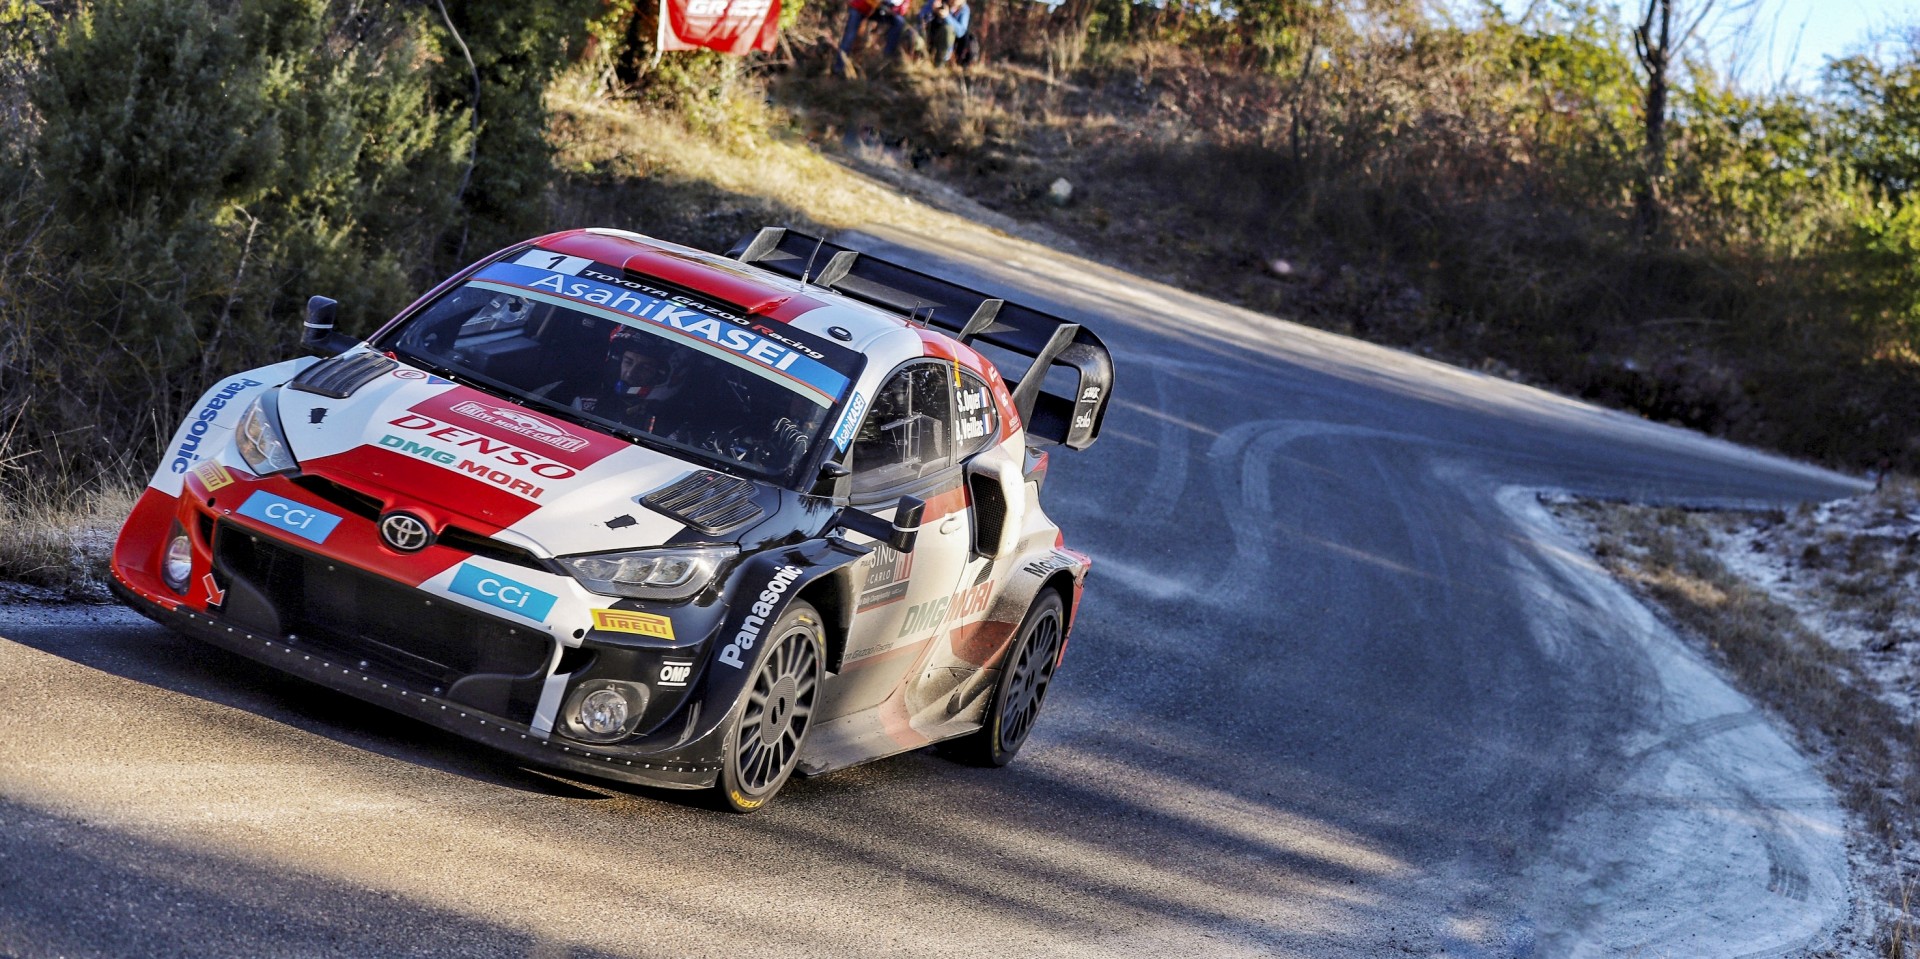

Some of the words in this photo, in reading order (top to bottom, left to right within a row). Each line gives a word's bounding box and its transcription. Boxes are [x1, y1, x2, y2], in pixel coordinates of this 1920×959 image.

[547, 255, 568, 270] 1
[528, 273, 800, 372] AsahiKASEI
[585, 269, 667, 298] TOYOTA
[671, 295, 750, 326] GAZOO
[752, 324, 825, 360] Racing
[171, 378, 264, 474] Panasonic
[455, 402, 497, 422] RALLYE
[836, 393, 866, 450] AsahiKASEI
[378, 434, 458, 465] DMG
[457, 459, 546, 499] MORI
[388, 414, 577, 481] DENSO
[264, 502, 316, 529] CCi
[476, 578, 530, 609] CCi
[718, 565, 804, 670] Panasonic
[897, 595, 949, 639] DMG
[943, 579, 995, 624] MORI
[598, 612, 667, 635] PIRELLI
[660, 665, 691, 682] OMP
